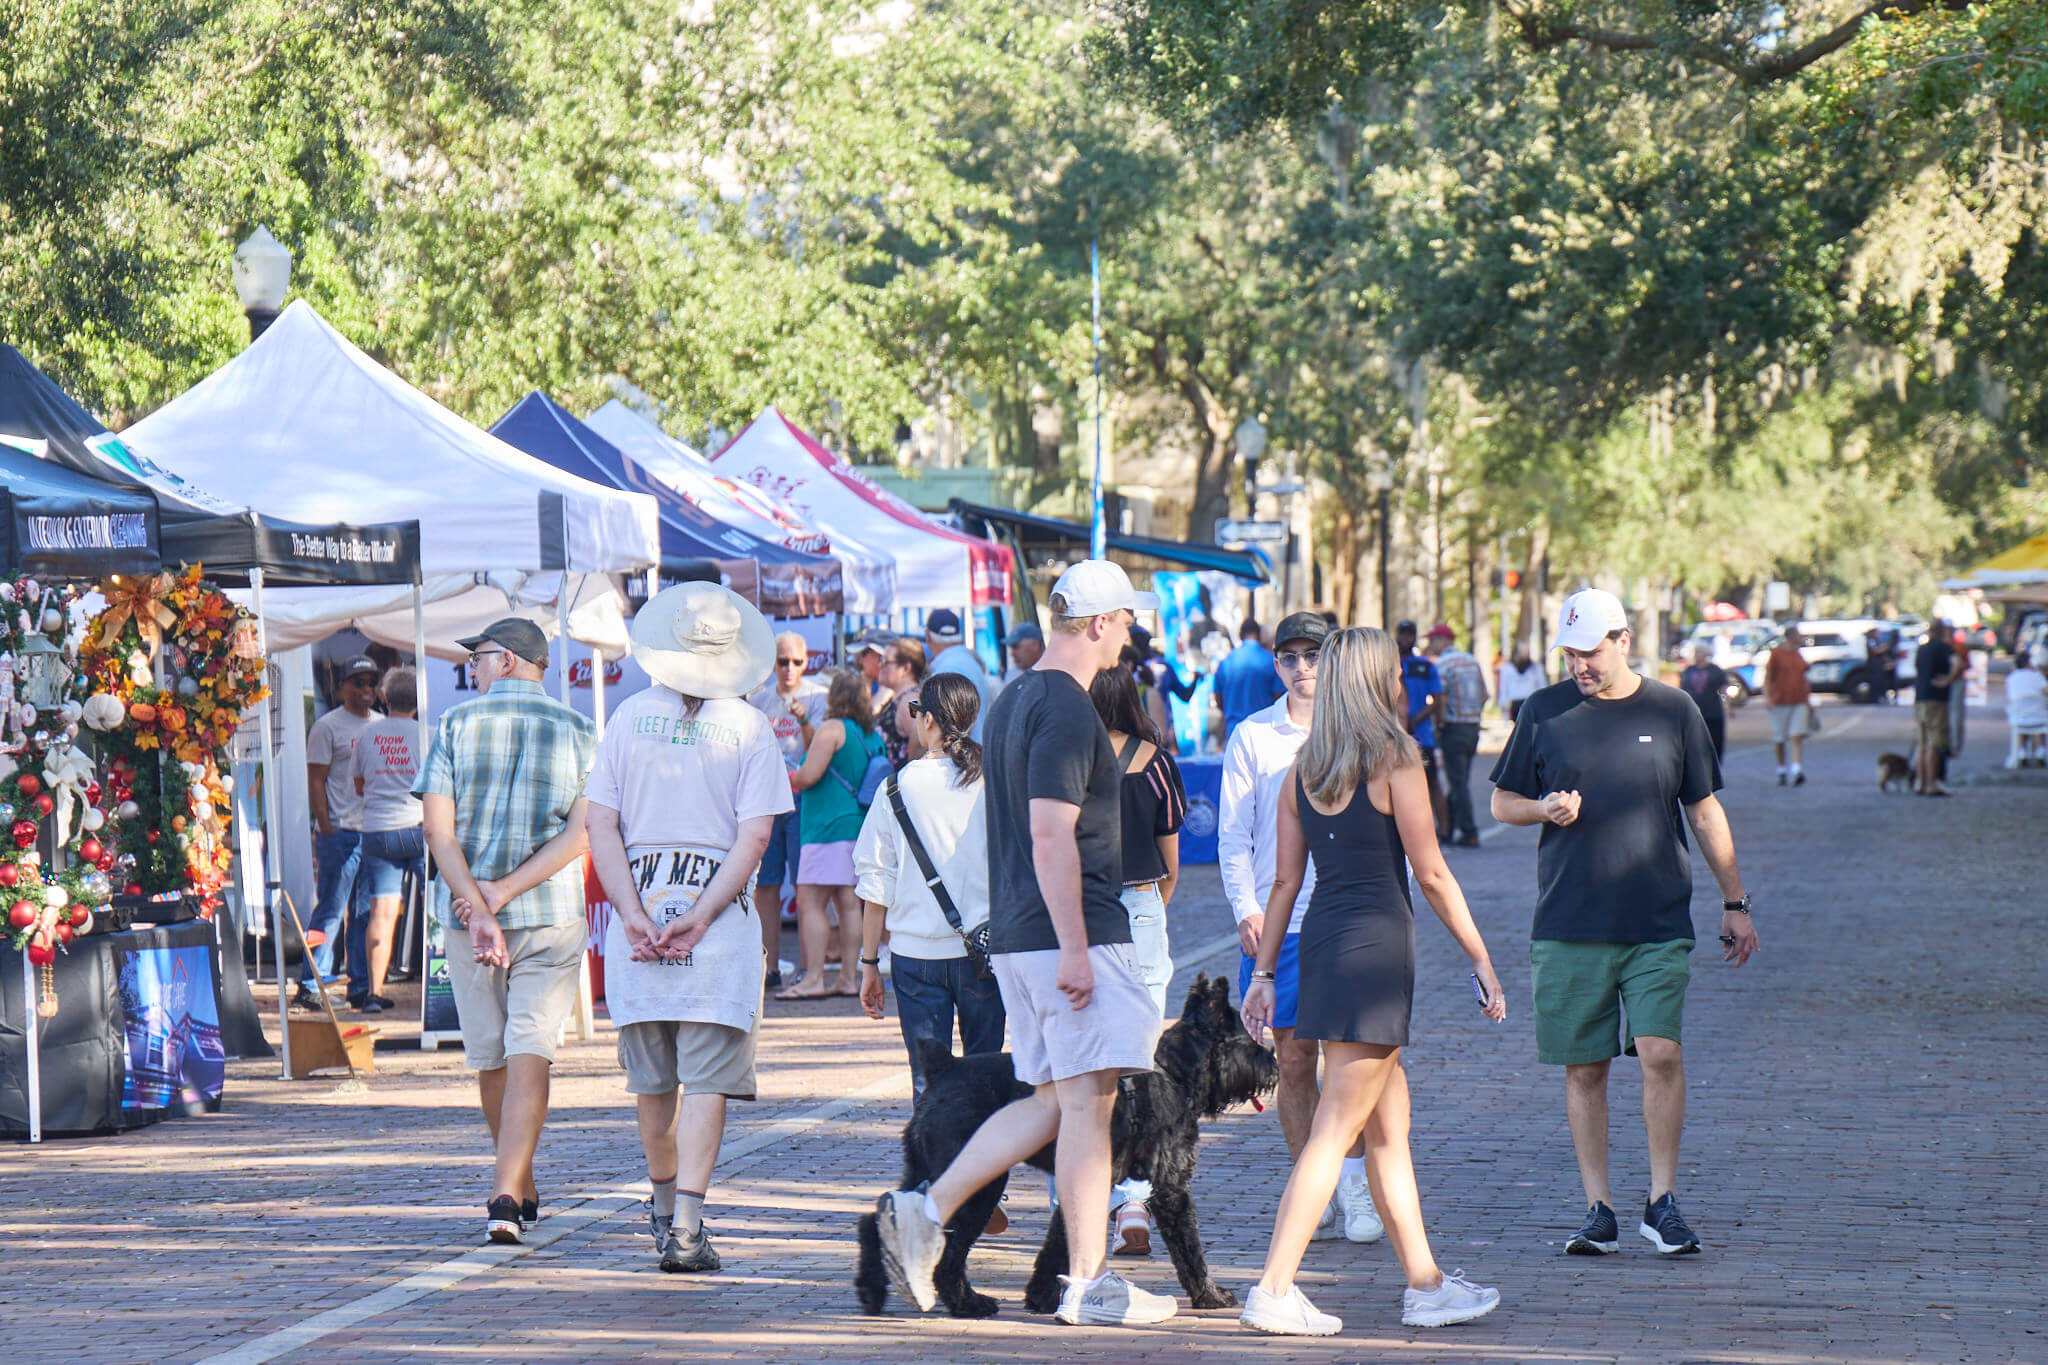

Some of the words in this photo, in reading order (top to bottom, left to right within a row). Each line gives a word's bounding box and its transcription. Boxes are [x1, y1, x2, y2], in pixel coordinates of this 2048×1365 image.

[28, 515, 69, 548] INTERIOR
[73, 515, 111, 548] EXTERIOR
[291, 533, 305, 556] The
[305, 534, 325, 558] Better
[326, 536, 340, 564] Way
[340, 538, 347, 560] to
[347, 542, 353, 560] a
[352, 538, 371, 562] Better
[374, 734, 405, 744] Know
[380, 745, 408, 755] More
[385, 755, 411, 765] Now
[1071, 1295, 1104, 1307] OKA
